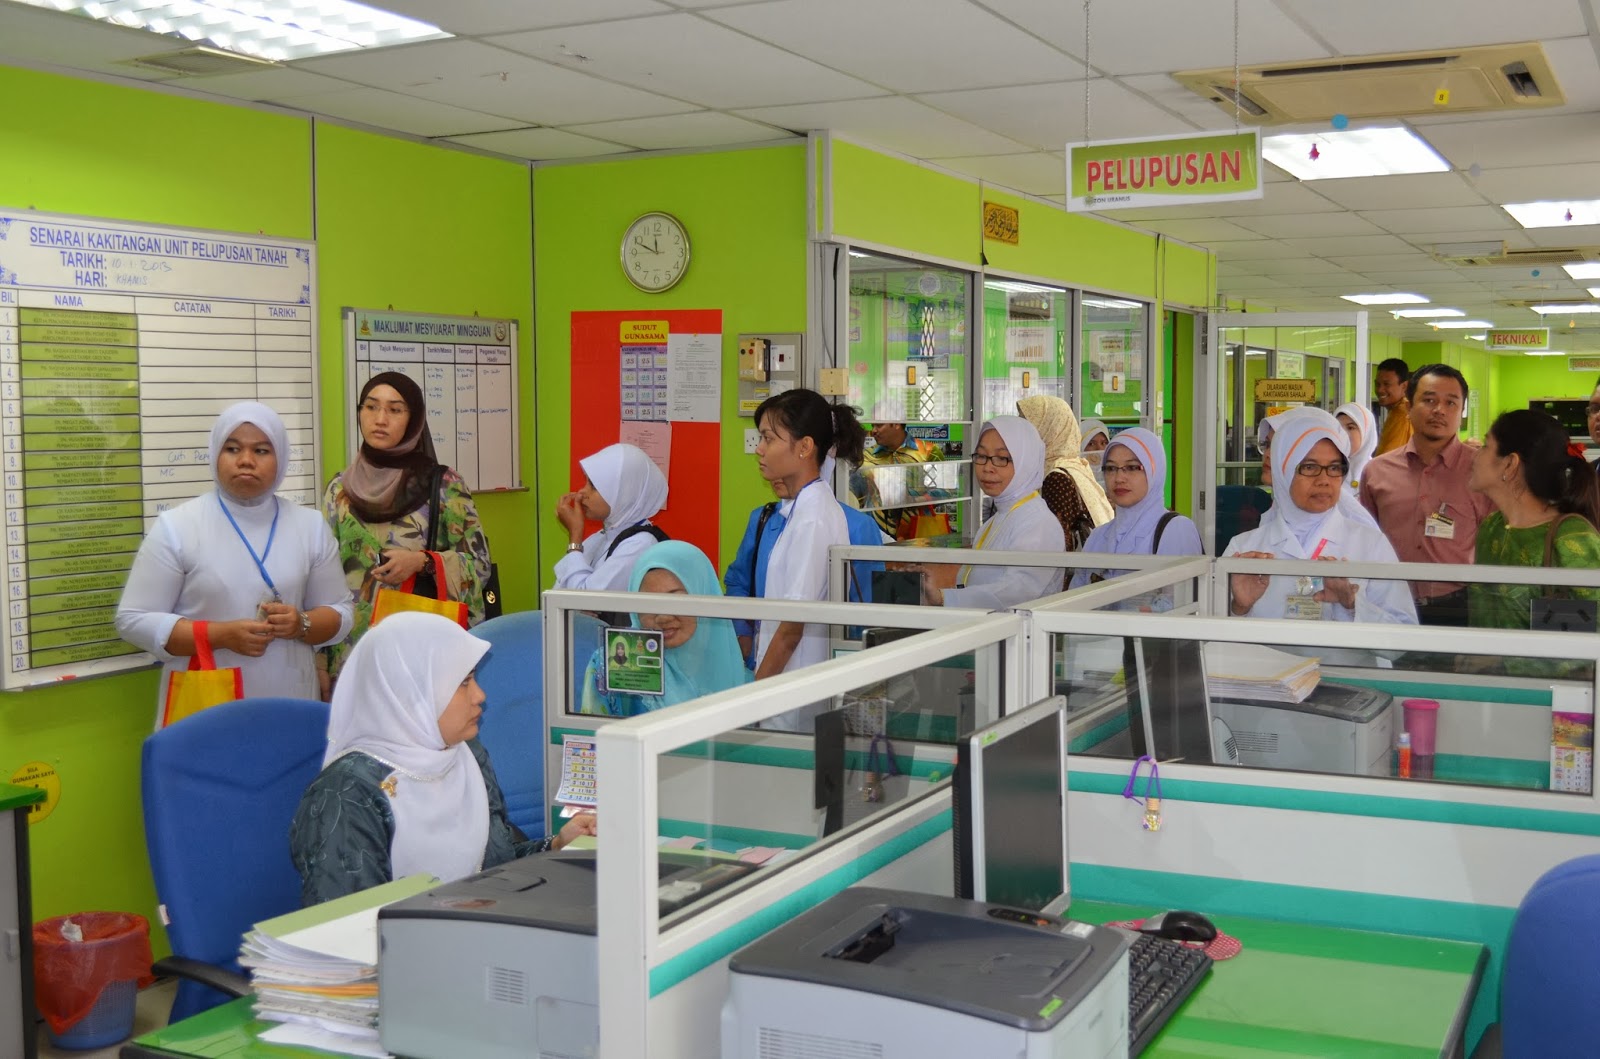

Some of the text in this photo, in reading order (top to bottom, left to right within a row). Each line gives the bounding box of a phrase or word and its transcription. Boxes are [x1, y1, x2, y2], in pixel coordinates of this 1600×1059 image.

[1087, 150, 1241, 192] PELUPUSAN
[1107, 195, 1131, 203] URANUS
[643, 226, 650, 236] 11
[654, 222, 662, 233] 12
[667, 226, 671, 236] 1
[634, 235, 643, 246] 10
[674, 234, 680, 245] 2
[29, 226, 288, 265] SENARAI KAKITANGAN UNIT PELUPUSAN TANAH
[631, 248, 638, 259] 9
[678, 247, 684, 258] 3
[60, 250, 108, 270] TARIKH:
[634, 261, 642, 272] 8
[673, 261, 680, 271] 4
[75, 270, 108, 288] HARI:
[642, 270, 649, 280] 7
[653, 274, 660, 285] 6
[665, 270, 672, 281] 5
[1, 291, 15, 304] BIL
[54, 294, 84, 307] NAMA
[174, 301, 212, 314] CATATAN
[268, 306, 297, 318] TARIKH
[374, 320, 491, 337] MAKLUMAT MESYUARAT MINGGUAN
[1491, 334, 1542, 345] TEKNIKAL
[379, 344, 416, 353] Tajuk Mesyuarat
[458, 348, 474, 356] Tempat
[1266, 383, 1288, 391] DILARANG
[1262, 390, 1289, 398] KAKITANGAN
[12, 774, 40, 783] GUNAKAN
